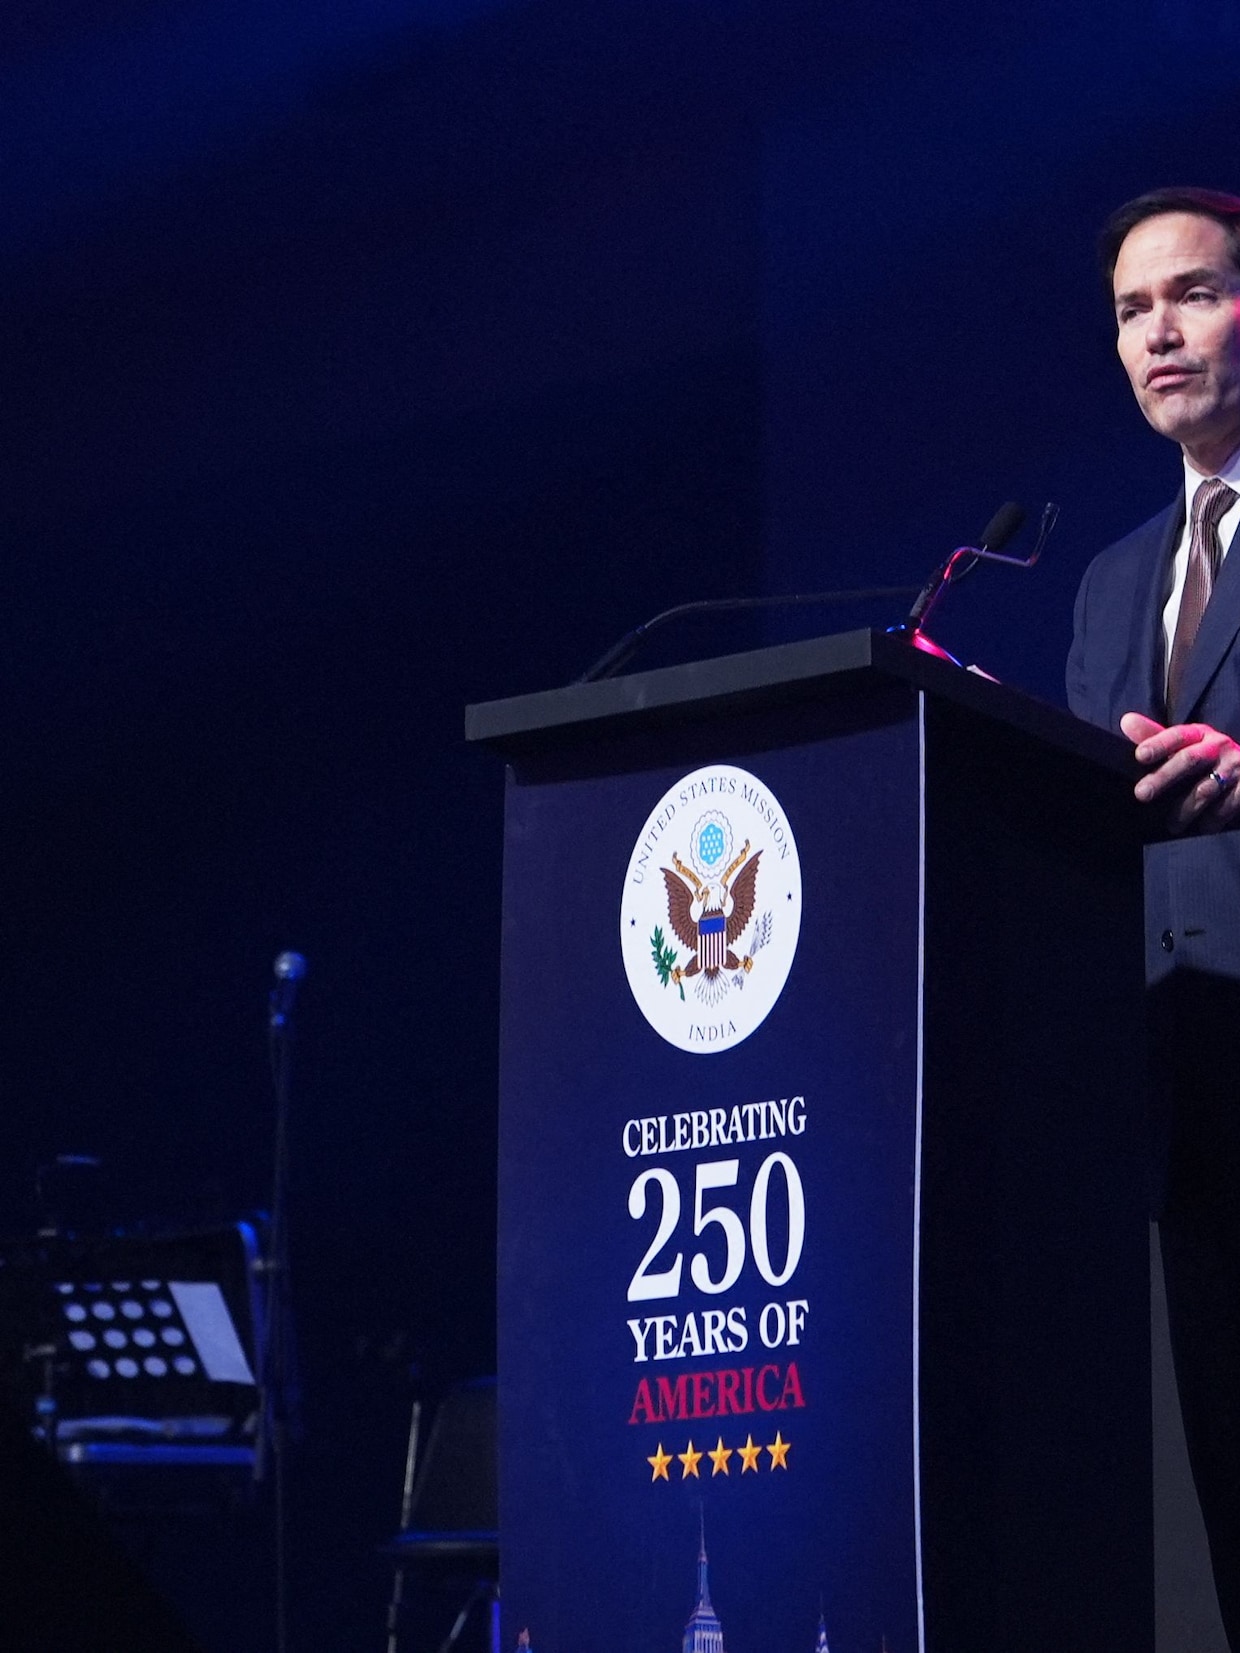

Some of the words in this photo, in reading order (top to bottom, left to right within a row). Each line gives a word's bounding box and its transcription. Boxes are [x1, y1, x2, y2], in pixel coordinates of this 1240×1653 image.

[633, 803, 677, 884] UNITED
[680, 777, 737, 806] STATES
[740, 783, 790, 861] MISSION
[688, 1020, 737, 1042] INDIA
[622, 1096, 807, 1157] CELEBRATING
[627, 1152, 805, 1301] 250
[627, 1307, 748, 1362] YEARS
[759, 1299, 809, 1349] OF
[628, 1361, 806, 1425] AMERICA
